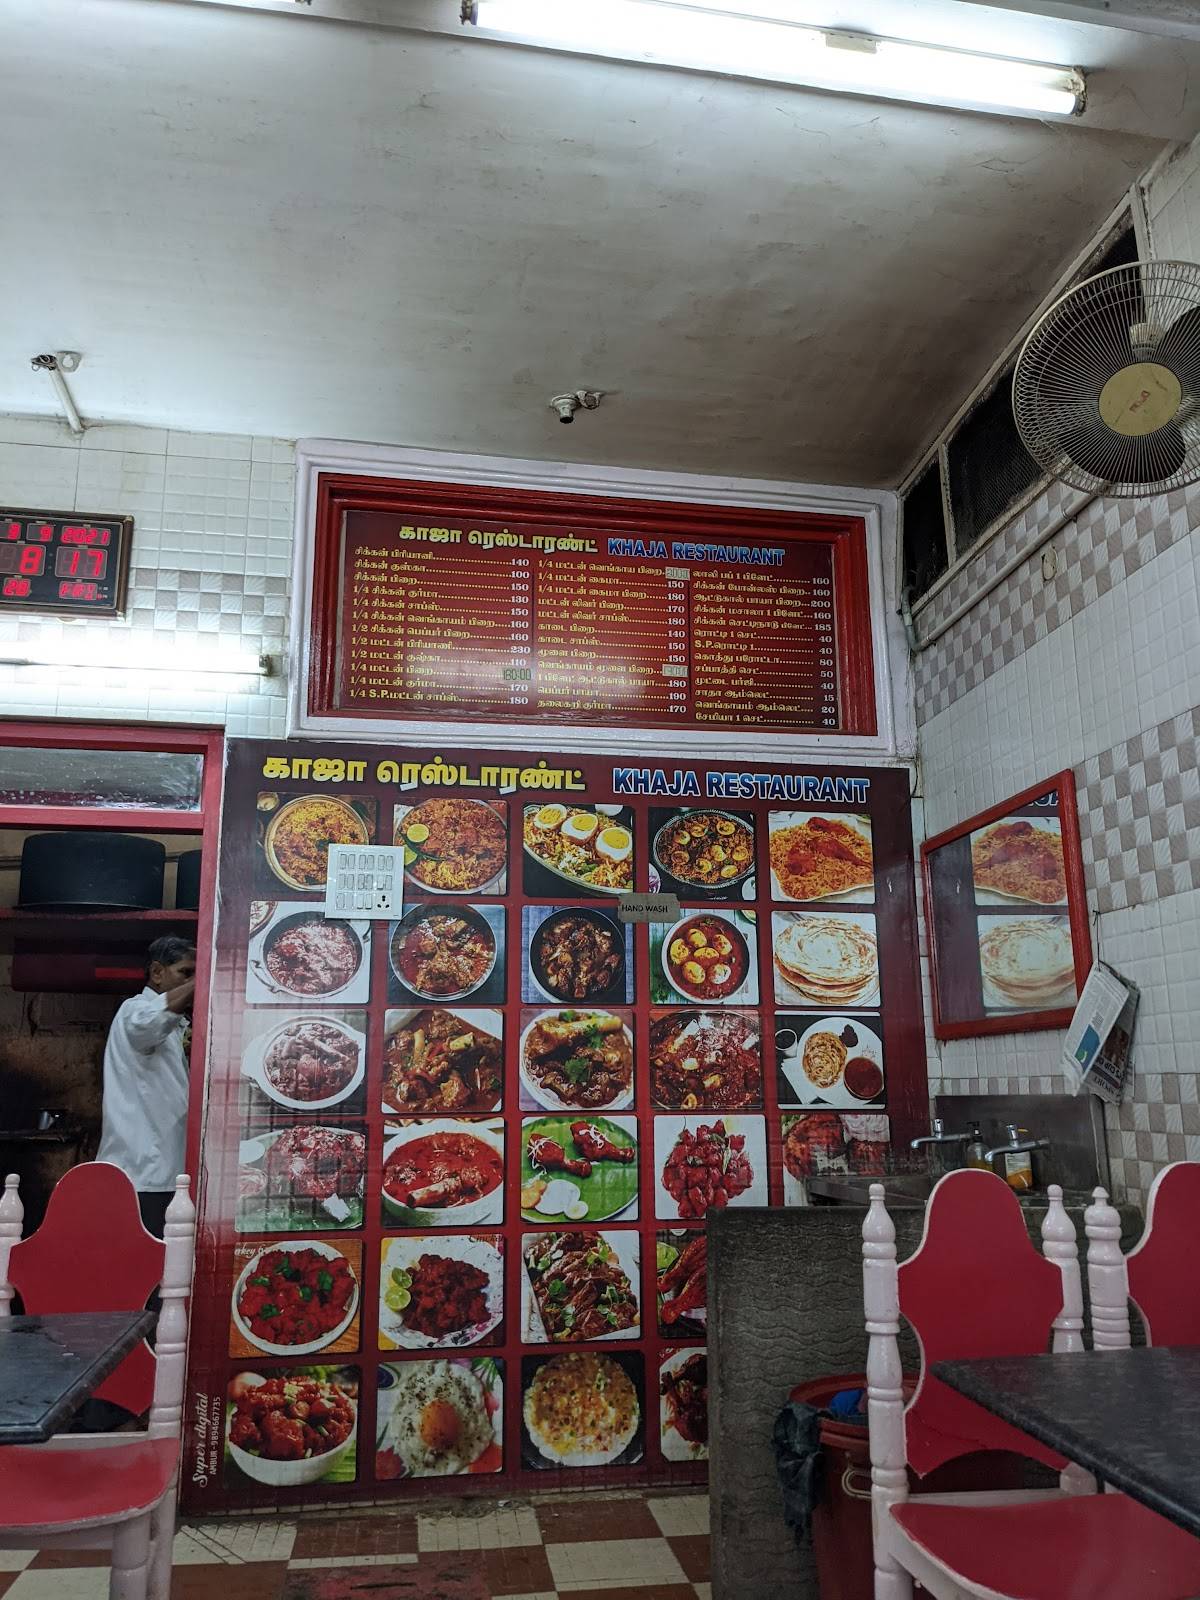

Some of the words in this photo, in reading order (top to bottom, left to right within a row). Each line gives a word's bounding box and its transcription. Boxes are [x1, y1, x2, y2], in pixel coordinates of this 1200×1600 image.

[61, 527, 110, 545] 2021
[399, 525, 462, 543] காஜா
[468, 528, 598, 554] ரெஸ்டாரண்ட்
[607, 537, 668, 558] KHAJA
[671, 542, 785, 566] RESTAURANT
[19, 546, 43, 574] 8
[70, 550, 103, 577] 17
[262, 756, 367, 782] காஜா
[377, 756, 586, 795] ரெஸ்டாரண்ட்
[612, 767, 701, 796] KHAJA
[706, 772, 870, 804] RESTAURANT
[194, 1393, 211, 1438] digital
[193, 1443, 208, 1487] Super
